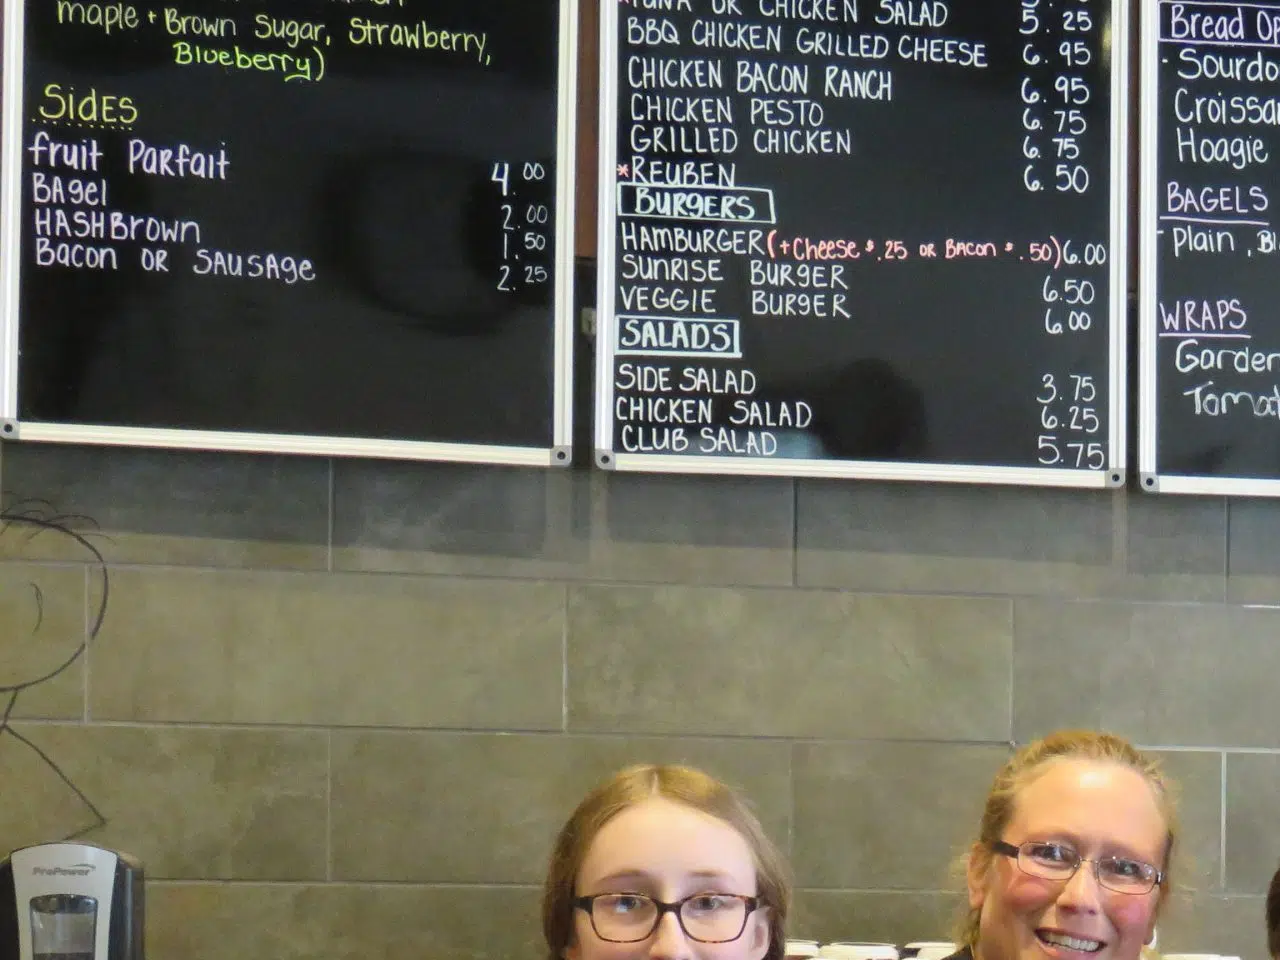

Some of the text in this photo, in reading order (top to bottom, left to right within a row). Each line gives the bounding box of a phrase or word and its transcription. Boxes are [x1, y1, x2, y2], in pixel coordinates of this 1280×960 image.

[758, 0, 858, 23] CHICKEN
[874, 0, 949, 28] SALAD
[1171, 4, 1245, 40] Bread
[57, 0, 140, 35] maple
[163, 7, 237, 37] Brown
[254, 13, 331, 49] Sugar,
[348, 17, 491, 66] Strawberry,
[627, 16, 989, 68] BBQ CHICKEN GRILLED CHEESE
[628, 55, 892, 102] CHICKEN BACON RANCH
[630, 92, 824, 128] CHICKEN PESTO
[28, 130, 104, 172] fruit
[630, 124, 851, 155] GRILLED CHICKEN
[1176, 127, 1269, 170] Hoagie
[1167, 181, 1269, 214] BAGELS
[140, 247, 169, 272] OR
[620, 285, 717, 313] VEGGIE
[1042, 275, 1095, 305] 6.50
[1159, 298, 1247, 332] WRAPS
[620, 319, 732, 351] SALADS
[615, 364, 757, 395] SIDE SALAD
[1036, 373, 1096, 404] 3.75
[616, 396, 813, 428] CHICKEN SALAD
[1041, 405, 1100, 433] 6.25
[622, 424, 777, 456] CLUB SALAD
[1037, 434, 1104, 470] 5.75
[32, 866, 90, 877] ProPower
